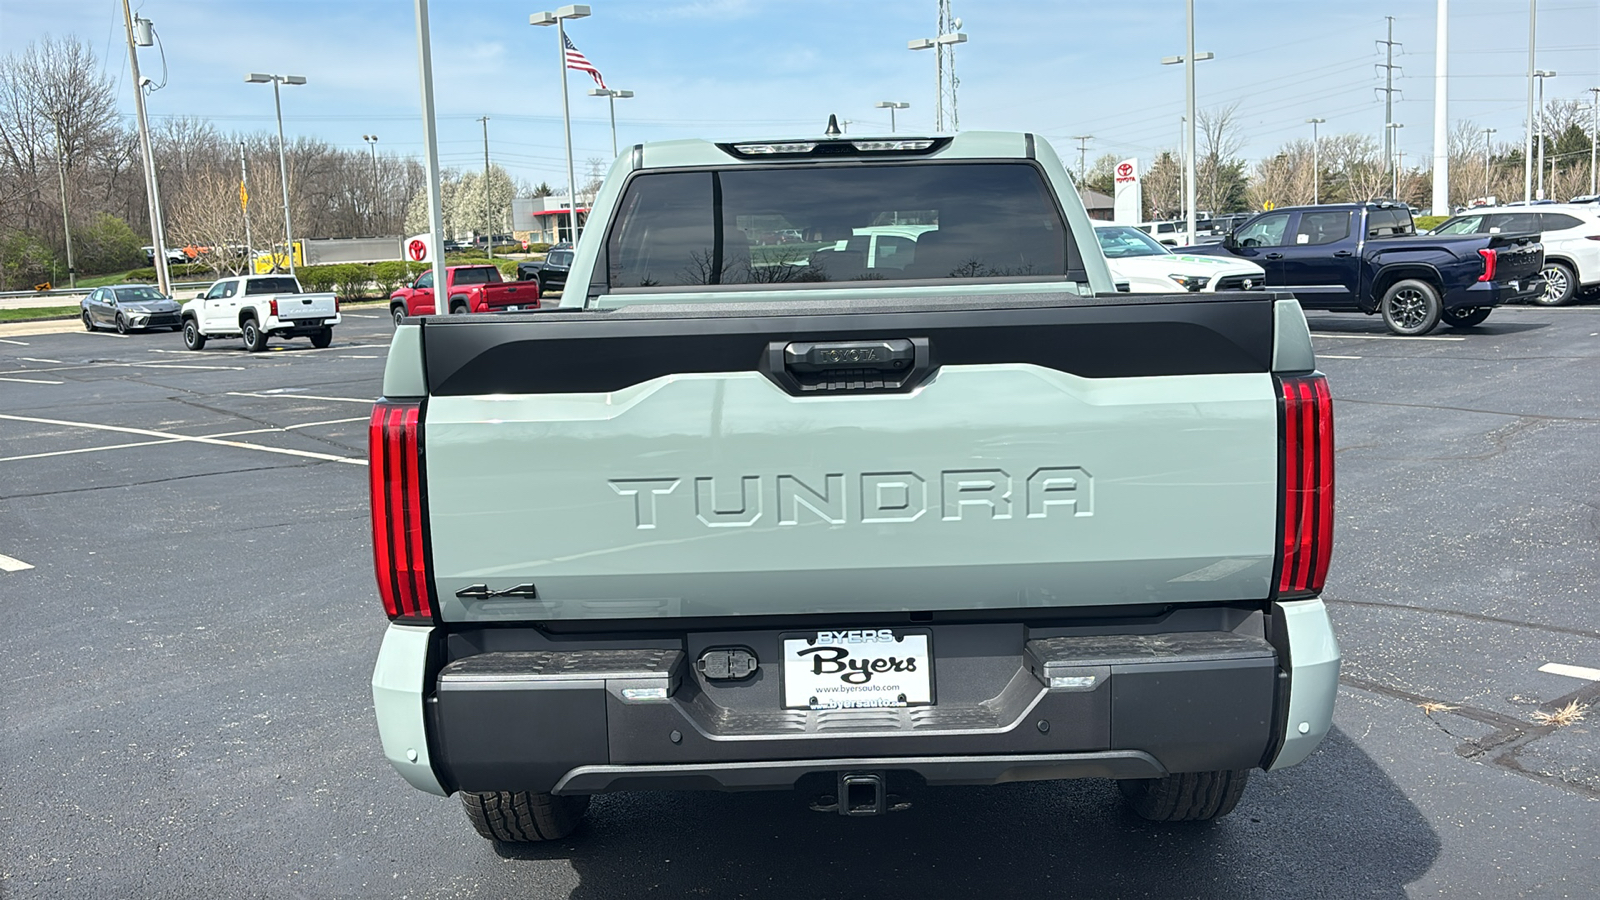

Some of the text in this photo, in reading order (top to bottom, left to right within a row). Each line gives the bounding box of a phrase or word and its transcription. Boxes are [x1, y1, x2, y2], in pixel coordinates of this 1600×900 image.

[820, 349, 879, 362] TOYOTA
[607, 466, 1095, 529] TUNDRA
[817, 629, 893, 644] BYERS
[797, 646, 917, 684] Byers
[815, 684, 900, 694] www.byersauto.com
